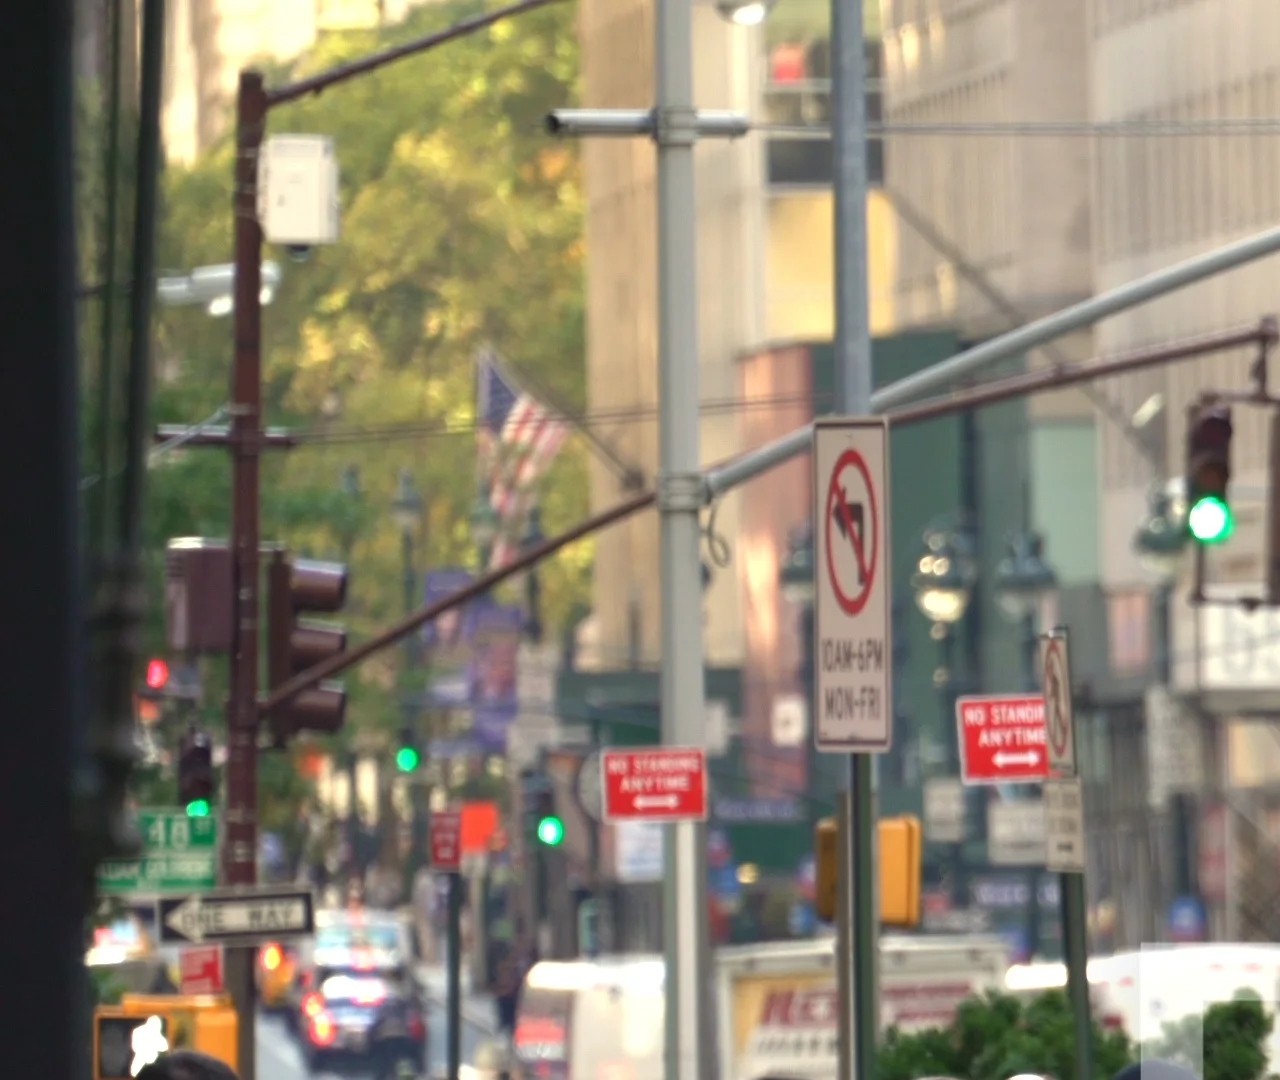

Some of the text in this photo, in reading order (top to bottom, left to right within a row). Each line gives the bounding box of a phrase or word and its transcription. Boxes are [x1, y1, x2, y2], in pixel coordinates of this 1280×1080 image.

[821, 638, 883, 673] 10AM-6PM
[824, 686, 881, 721] MON-FRI
[964, 702, 1045, 728] NO STANDIN
[978, 727, 1047, 748] ANYTIME
[608, 756, 700, 775] NO STANDING
[618, 774, 690, 794] ANYTIME
[181, 903, 294, 933] ONE WAY
